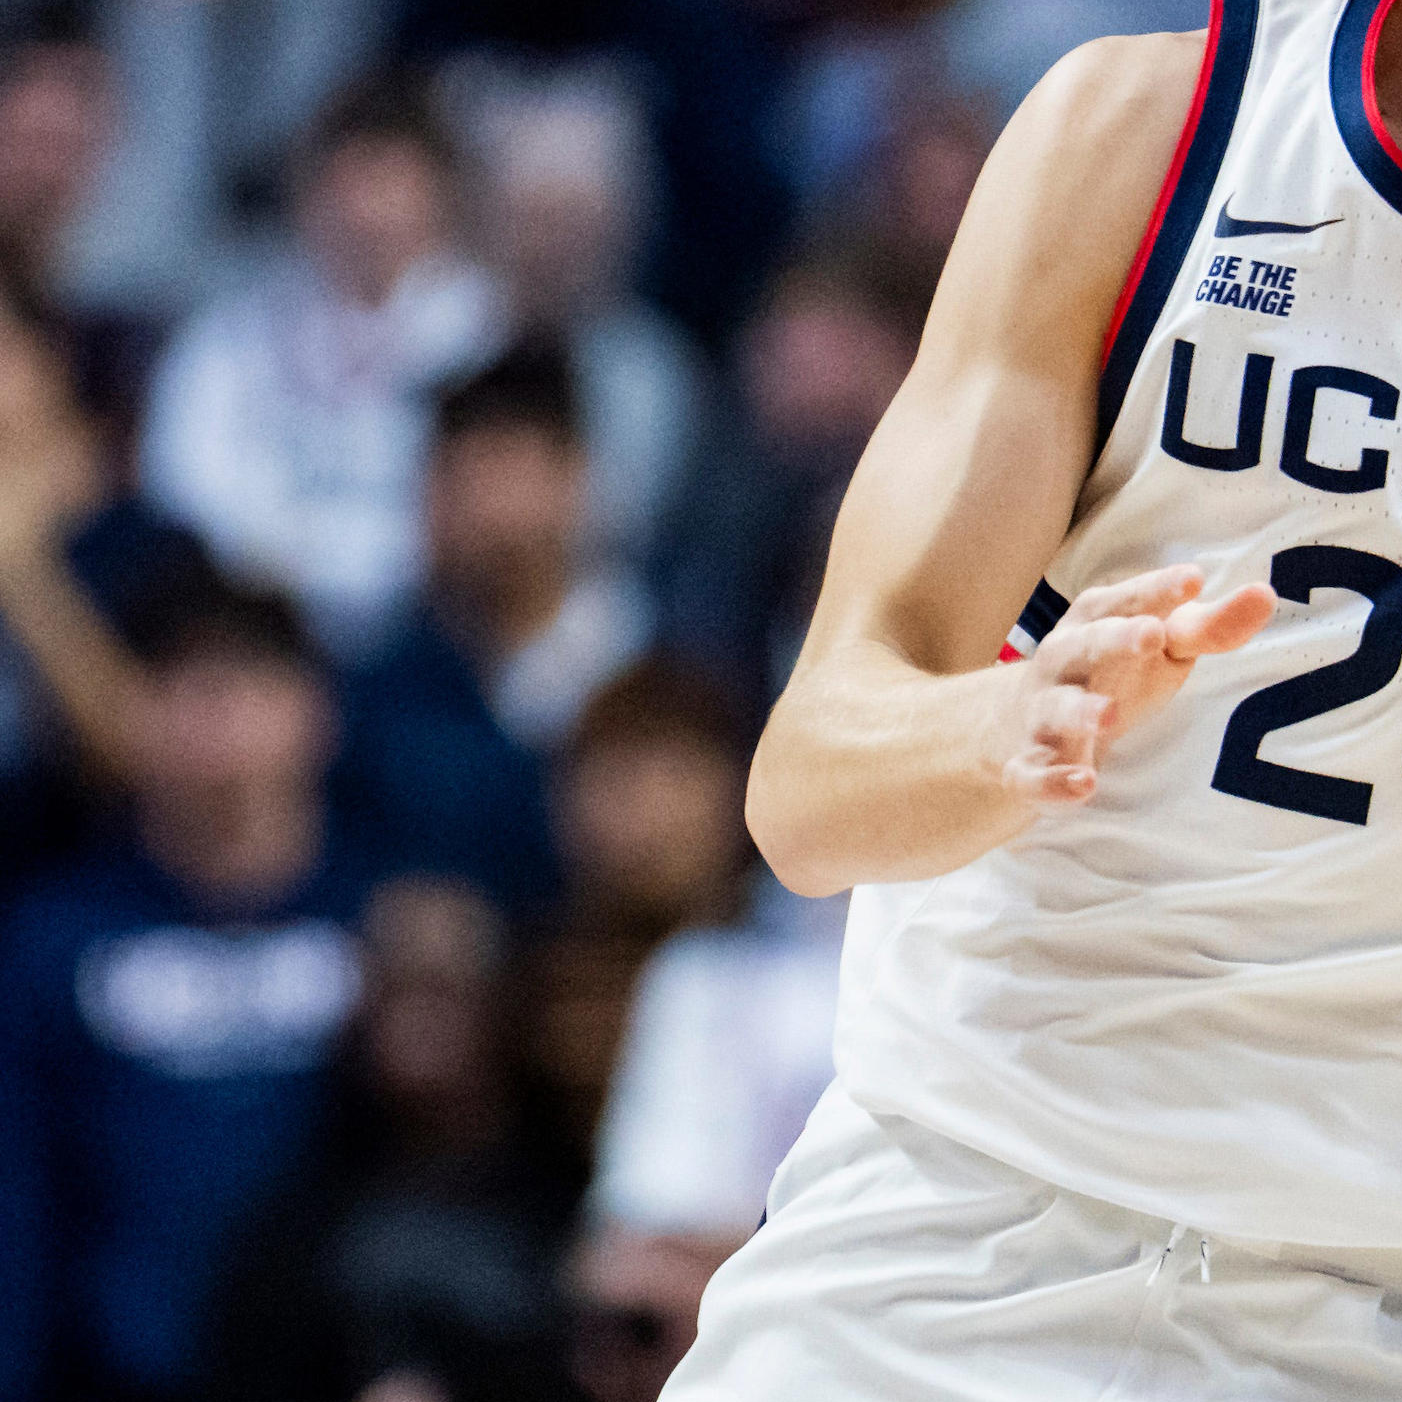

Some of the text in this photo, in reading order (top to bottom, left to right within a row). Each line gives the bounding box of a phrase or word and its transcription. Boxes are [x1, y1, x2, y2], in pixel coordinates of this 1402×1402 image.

[1208, 255, 1297, 291] BE THE
[1195, 278, 1295, 317] CHANGE
